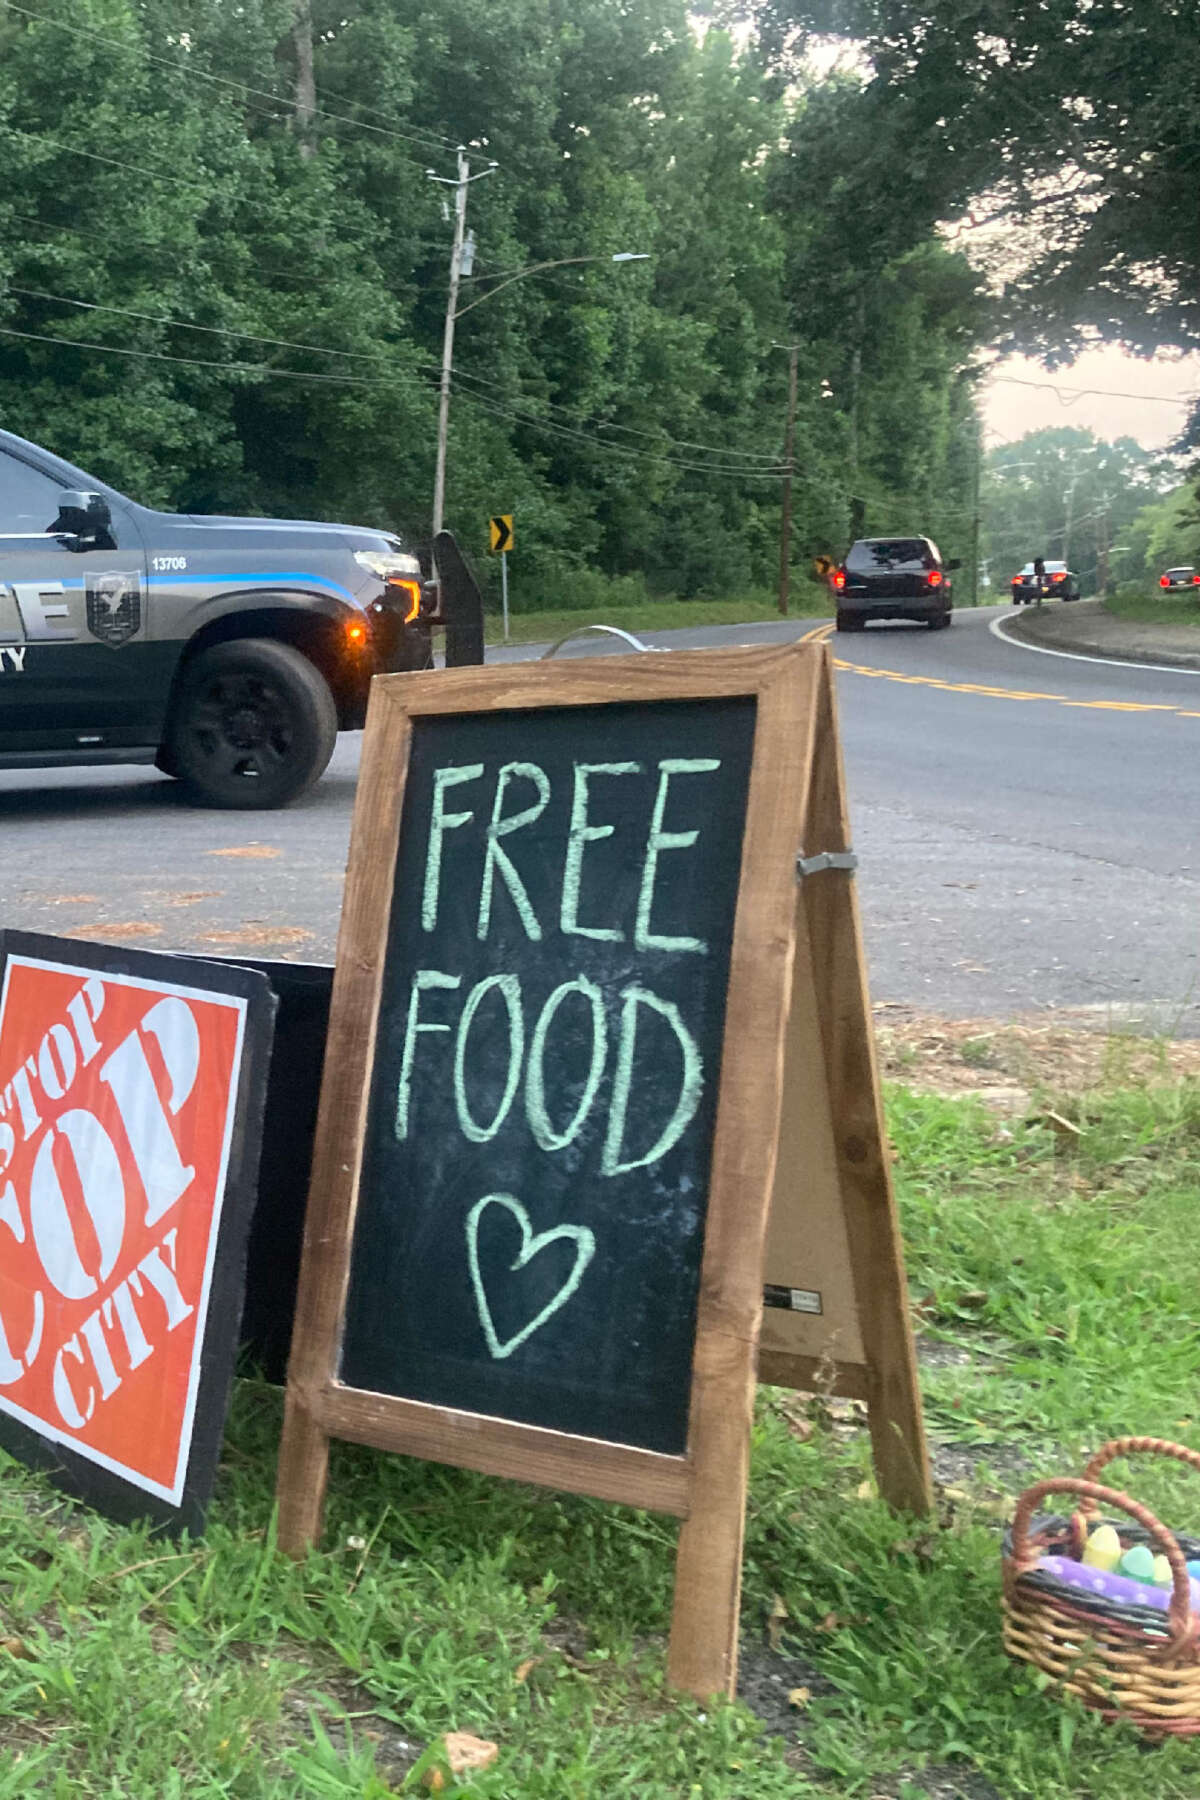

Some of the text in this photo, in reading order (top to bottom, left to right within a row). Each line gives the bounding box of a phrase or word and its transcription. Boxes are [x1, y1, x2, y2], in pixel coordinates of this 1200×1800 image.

[422, 758, 722, 954] FREE
[395, 969, 705, 1177] FOOD
[53, 1228, 194, 1429] CITY
